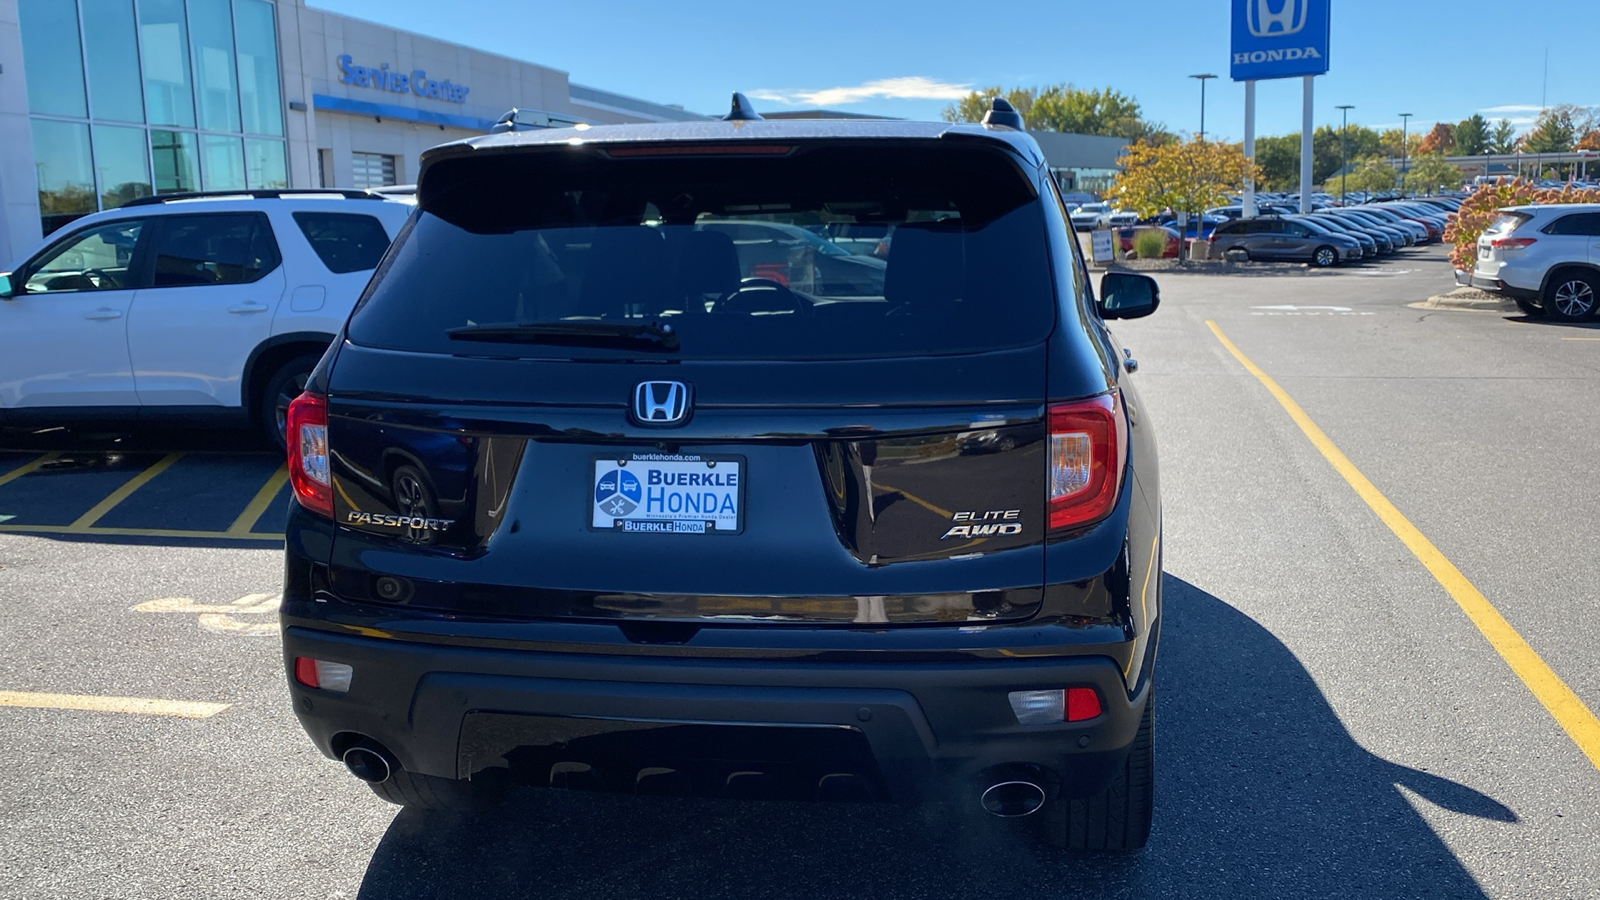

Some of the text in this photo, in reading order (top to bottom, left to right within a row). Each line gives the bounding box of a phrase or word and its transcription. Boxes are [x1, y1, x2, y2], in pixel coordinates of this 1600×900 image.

[1233, 46, 1321, 65] HONDA
[336, 54, 470, 104] Service Center
[632, 453, 701, 461] buerklehonda.com
[647, 469, 737, 487] BUERKLE
[646, 486, 736, 514] HONDA
[347, 510, 455, 531] PASSPORT
[952, 509, 1021, 522] ELITE
[624, 520, 704, 532] BUERKLE HONDA
[940, 522, 1023, 539] AWD
